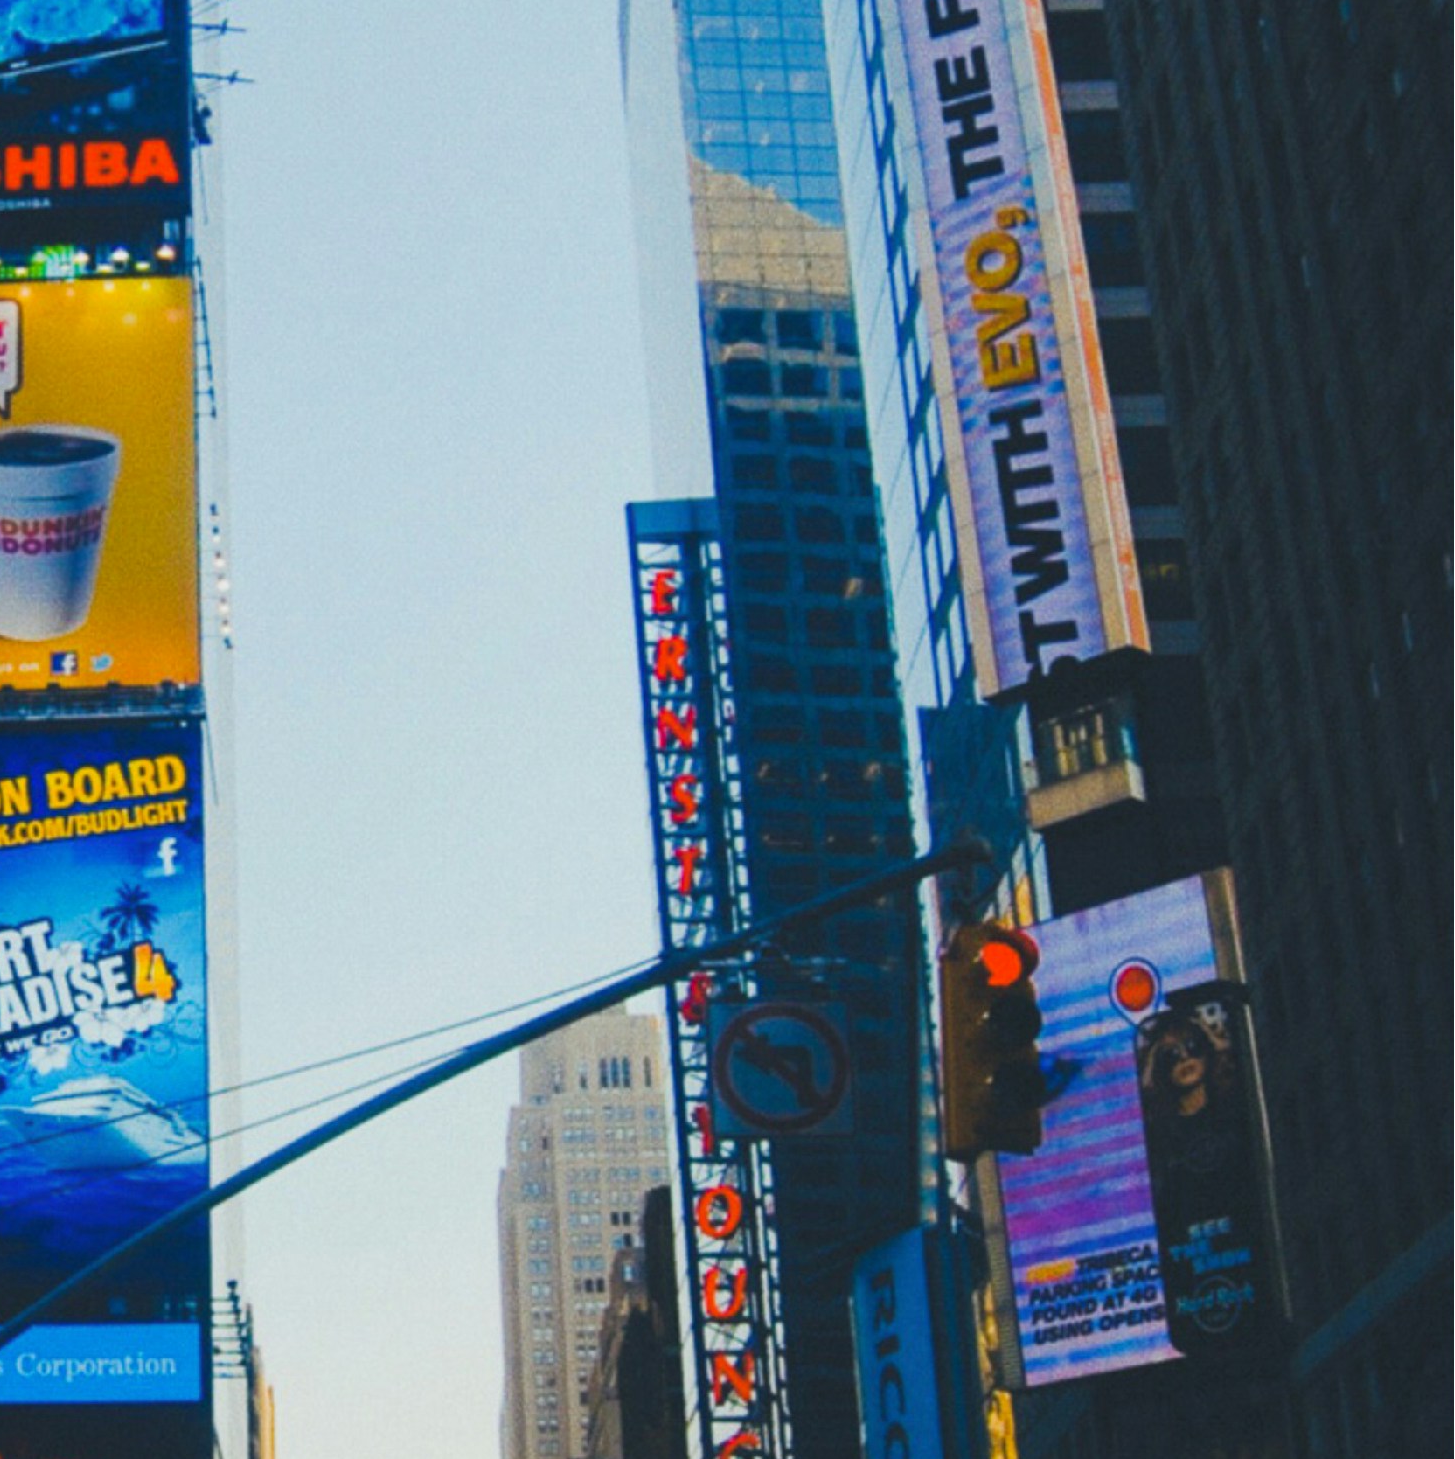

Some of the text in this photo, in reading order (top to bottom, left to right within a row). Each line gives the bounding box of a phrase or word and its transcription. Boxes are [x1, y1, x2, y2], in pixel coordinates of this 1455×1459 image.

[934, 45, 1005, 200] THE
[963, 205, 1040, 391] EVO,
[989, 399, 1070, 607] WITH
[650, 569, 700, 896] ERNST
[45, 755, 186, 809] BOARD
[133, 943, 176, 1002] 4
[1028, 1274, 1108, 1306] PARKING
[1031, 1300, 1097, 1326] FOUND
[1102, 1292, 1127, 1311] AT
[1033, 1318, 1095, 1345] USING
[15, 1351, 178, 1384] Corporation
